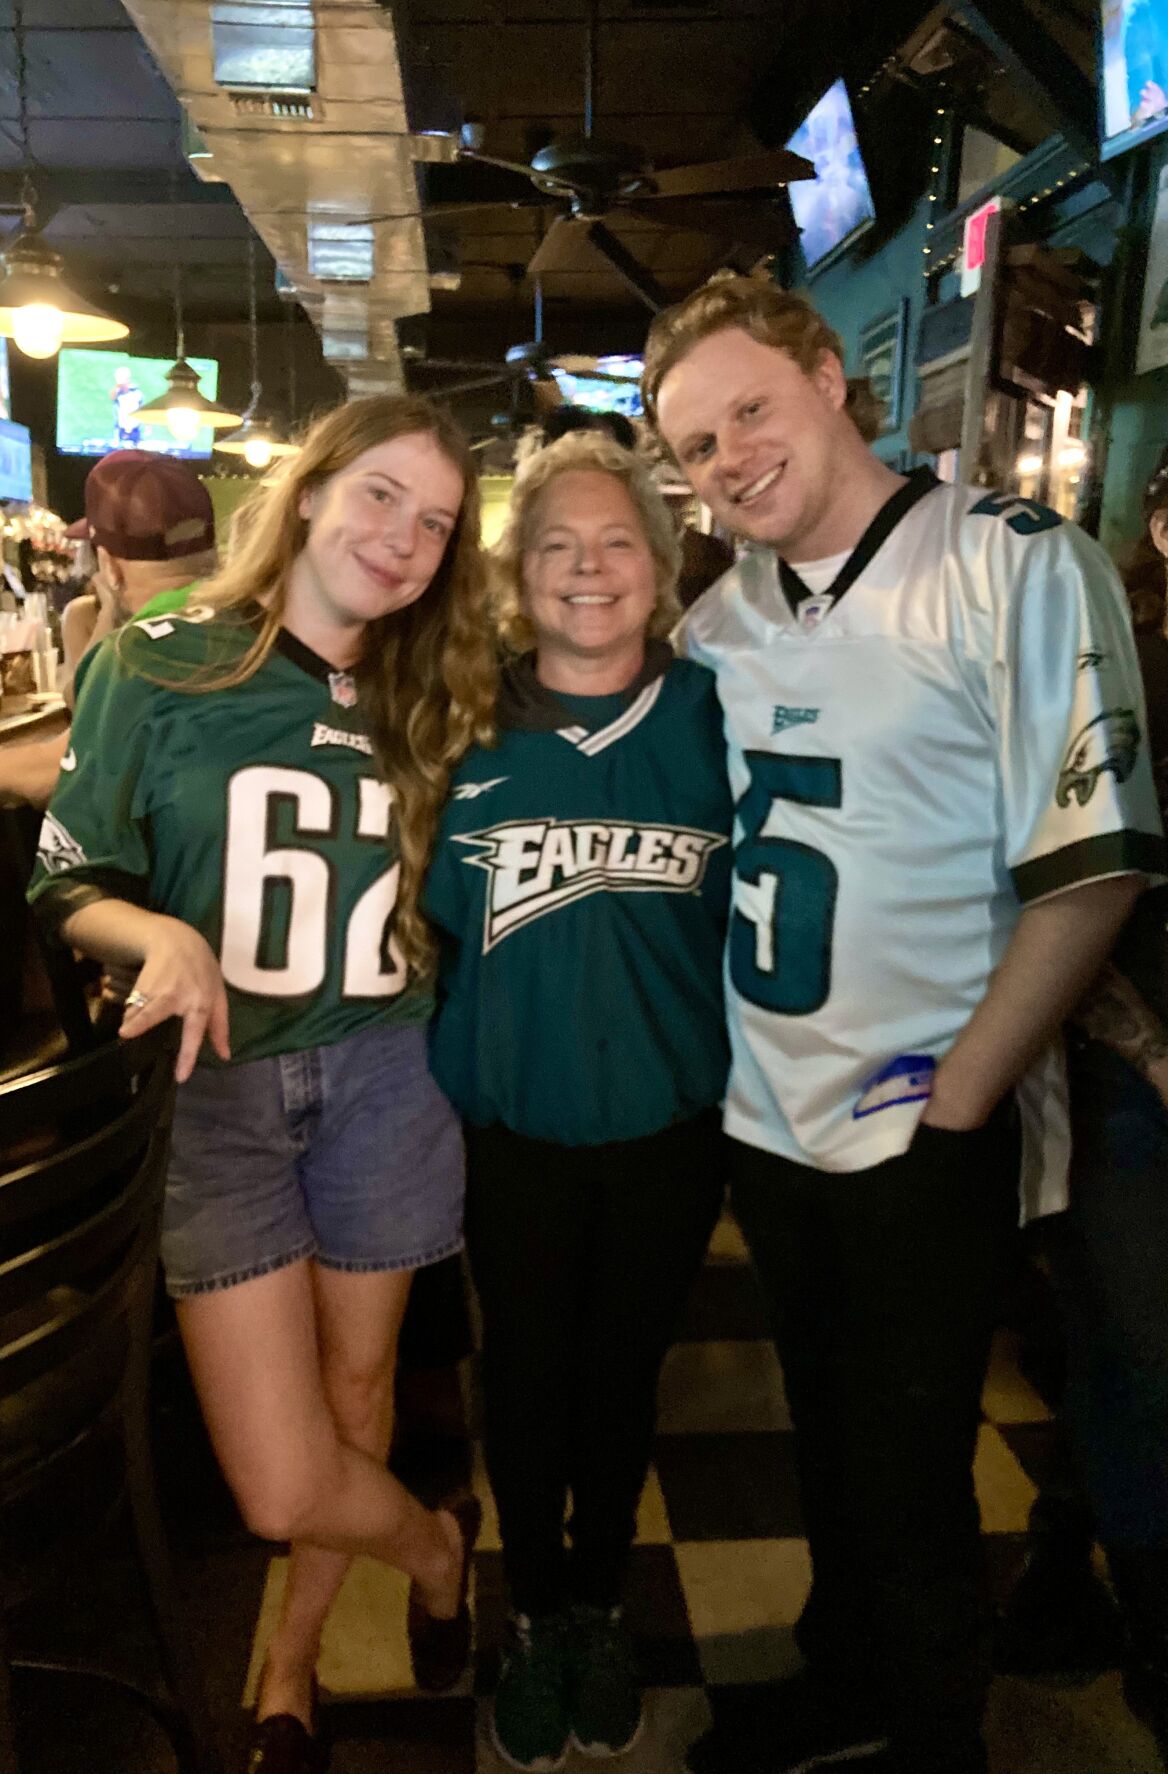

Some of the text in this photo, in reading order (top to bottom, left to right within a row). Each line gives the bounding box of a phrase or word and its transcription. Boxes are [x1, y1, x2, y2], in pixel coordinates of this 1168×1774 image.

[220, 765, 407, 996] 62
[462, 818, 725, 930] EAGLES
[729, 749, 842, 1016] 5
